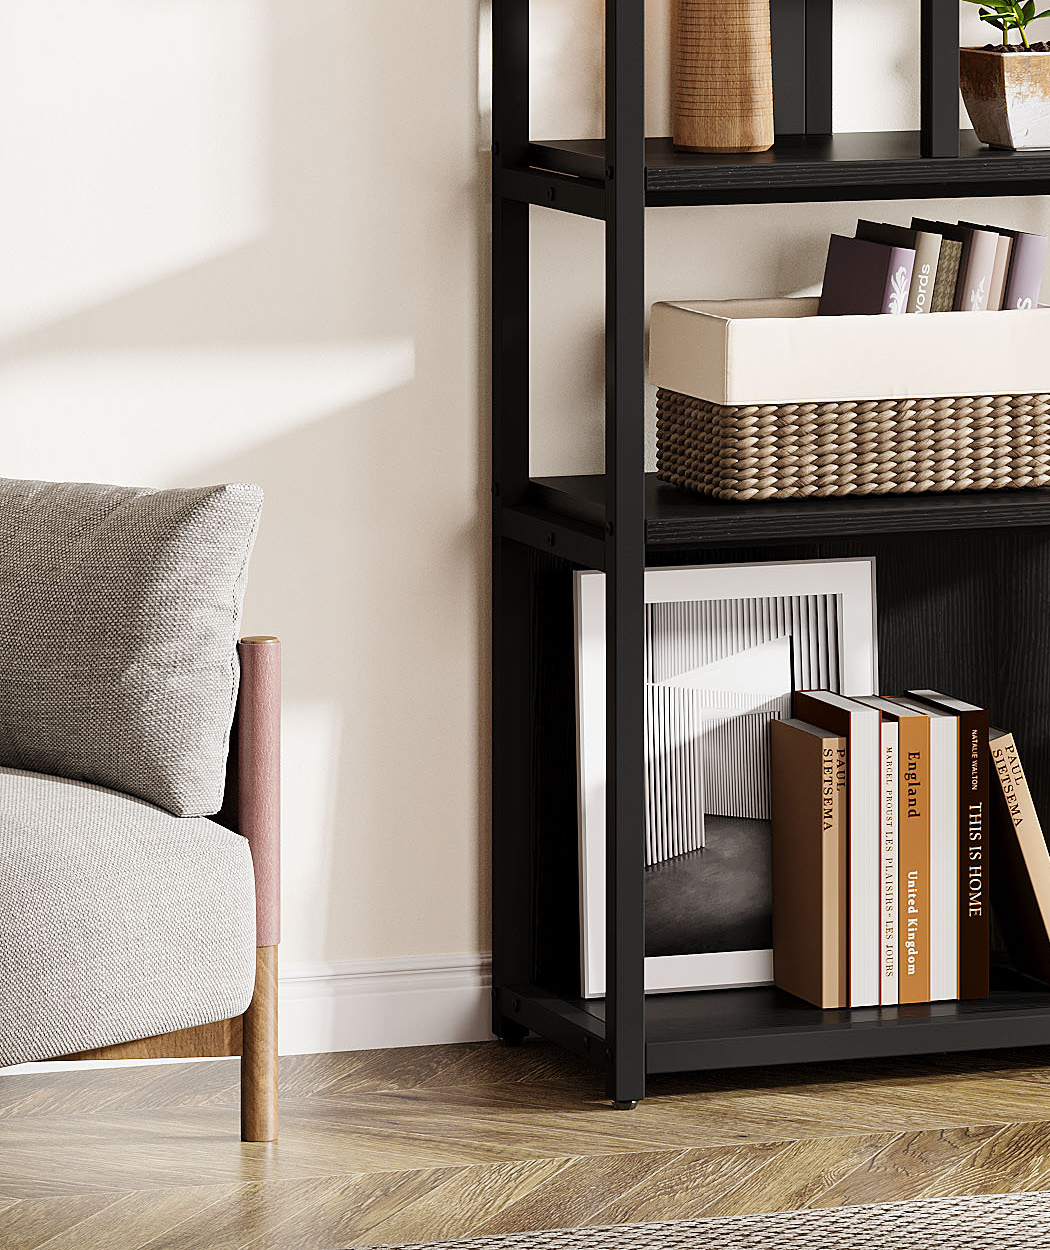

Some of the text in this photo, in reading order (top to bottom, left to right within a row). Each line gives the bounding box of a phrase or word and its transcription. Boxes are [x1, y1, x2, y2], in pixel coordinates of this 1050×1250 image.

[823, 748, 833, 831] SIETSEMA
[836, 748, 845, 792] PAUL
[904, 751, 921, 818] England
[971, 729, 979, 790] NATALIE WALTON
[993, 748, 1024, 827] SIETSEMA
[1005, 744, 1023, 786] PAUL
[885, 831, 893, 852] LES
[969, 801, 982, 917] THIS IS HOME
[885, 921, 893, 940] LES
[905, 871, 919, 975] United Kingdom
[885, 945, 893, 977] JOURS
